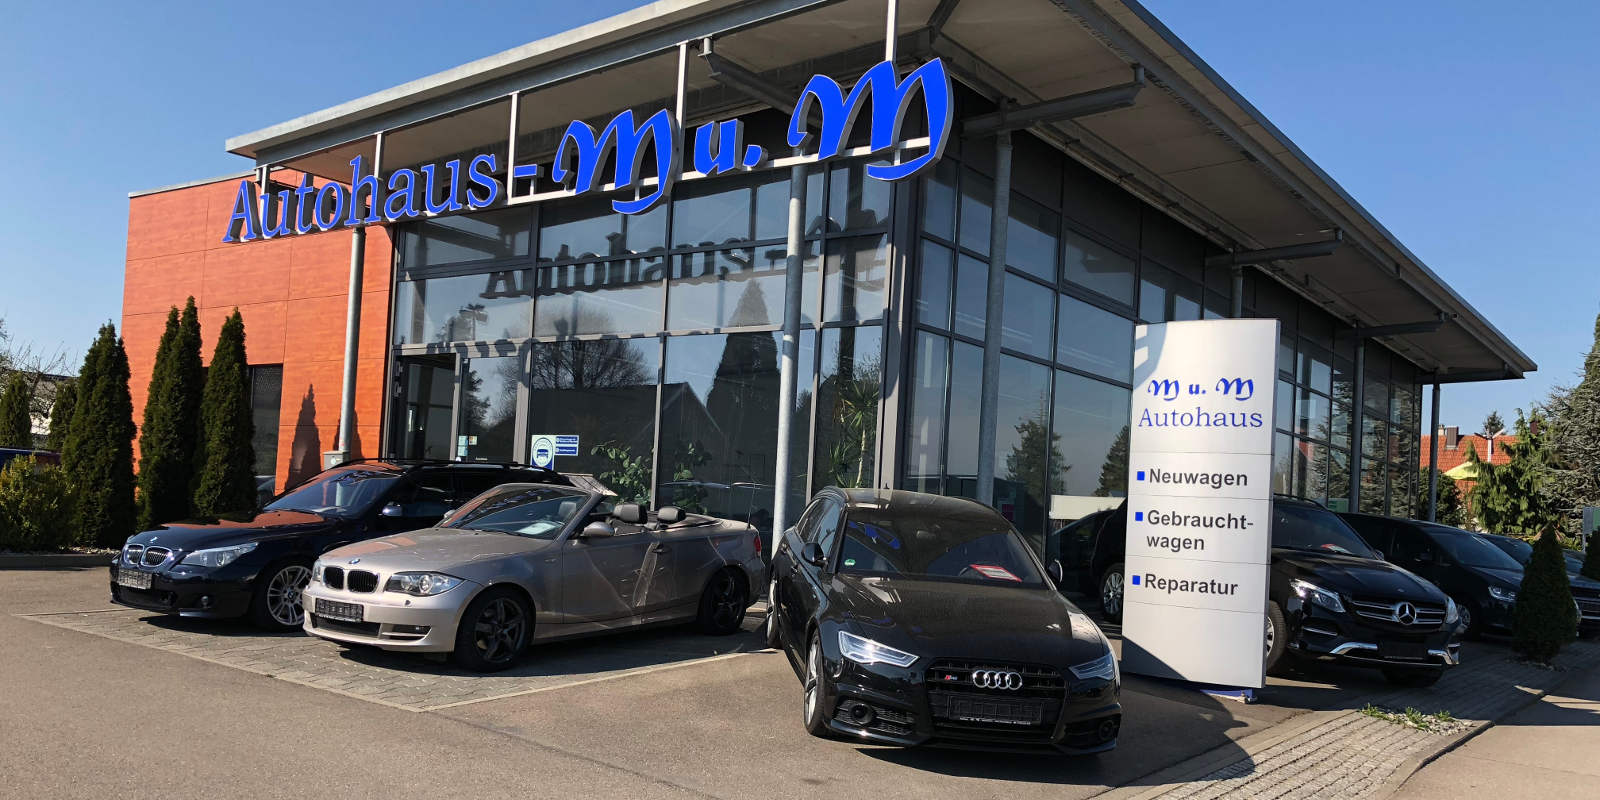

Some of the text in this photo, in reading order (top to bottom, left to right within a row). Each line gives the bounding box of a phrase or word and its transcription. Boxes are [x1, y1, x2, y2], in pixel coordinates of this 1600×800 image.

[552, 108, 675, 214] M
[694, 119, 762, 175] u.
[787, 57, 950, 180] M
[1188, 383, 1207, 395] u.
[1138, 406, 1263, 428] Autohaus
[1149, 468, 1248, 490] Neuwagen
[1147, 509, 1254, 530] Gebraucht-
[1146, 534, 1205, 553] wagen
[1144, 573, 1239, 596] Reparatur
